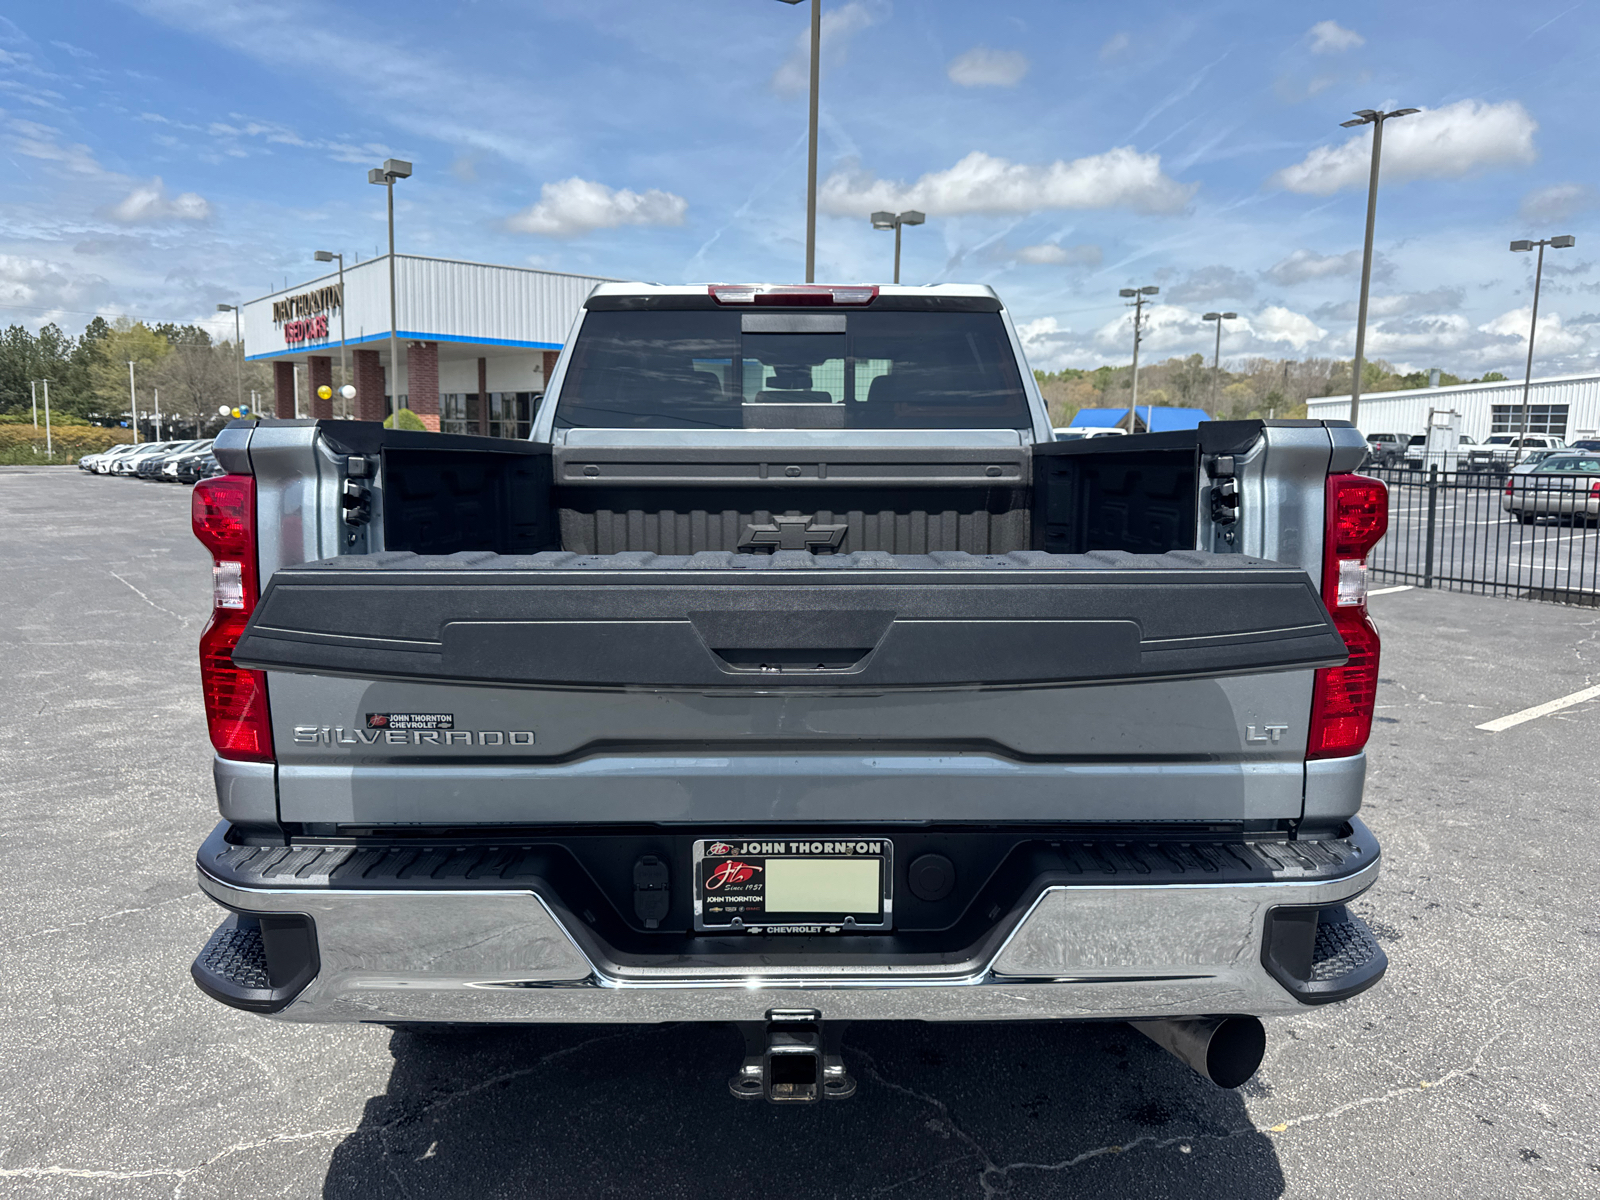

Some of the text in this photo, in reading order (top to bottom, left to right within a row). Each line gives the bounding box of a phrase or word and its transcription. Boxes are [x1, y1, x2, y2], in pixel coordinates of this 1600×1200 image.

[272, 284, 342, 322] JOHN THORNTON
[284, 315, 327, 343] USED CARS
[293, 726, 536, 746] SILVERADO
[1246, 725, 1289, 741] LT
[740, 843, 880, 854] JOHN THORNTON
